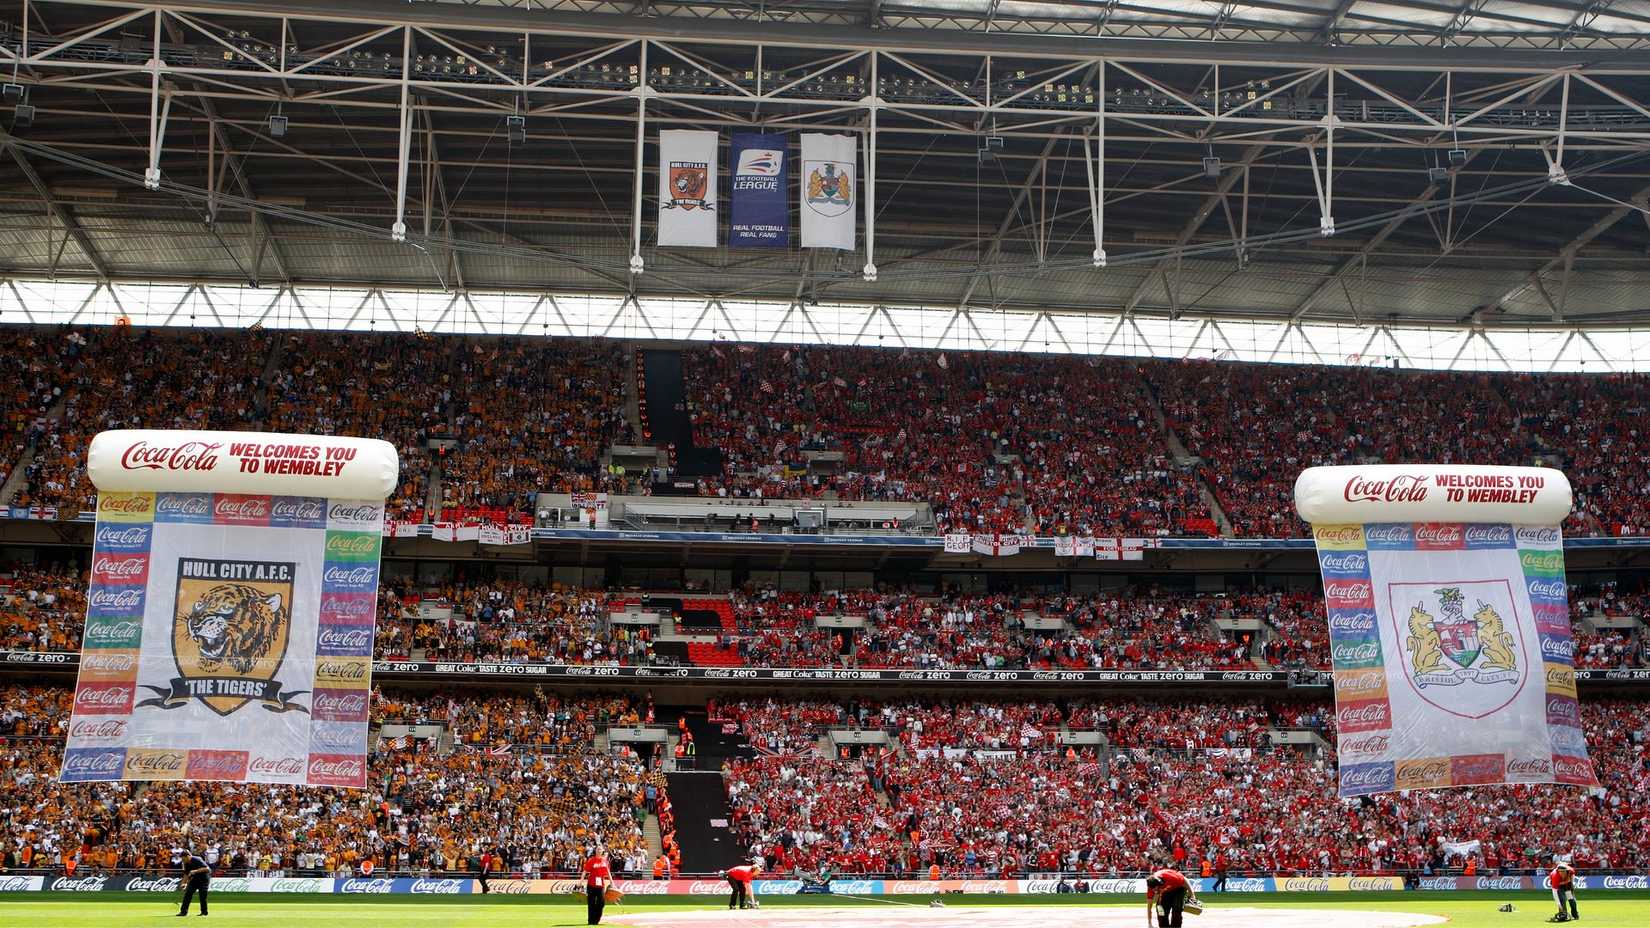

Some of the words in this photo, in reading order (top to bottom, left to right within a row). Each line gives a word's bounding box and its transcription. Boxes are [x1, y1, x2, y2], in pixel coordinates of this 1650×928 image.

[733, 181, 778, 190] LEAGUE
[751, 224, 784, 232] FOOTBALL
[229, 443, 323, 460] WELCOMES
[325, 447, 357, 462] YOU
[240, 457, 260, 474] TO
[263, 459, 346, 477] WEMBLEY
[1435, 474, 1515, 489] WELCOMES
[1518, 475, 1545, 490] YOU
[1446, 487, 1463, 503] TO
[1467, 489, 1539, 504] WEMBLEY
[182, 560, 217, 578] HULL
[220, 562, 254, 579] CITY
[255, 563, 292, 581] A.F.C.
[38, 654, 65, 663] zero
[394, 662, 419, 671] zero
[436, 664, 456, 672] GREAT
[499, 665, 525, 674] zero
[594, 667, 619, 675] zero
[733, 670, 757, 678] zero
[773, 670, 792, 678] GREAT
[835, 671, 859, 679] zero
[927, 671, 950, 680] zero
[994, 672, 1018, 680] zero
[1060, 672, 1085, 680] zero
[1160, 672, 1184, 680] zero
[1250, 672, 1273, 680] zero
